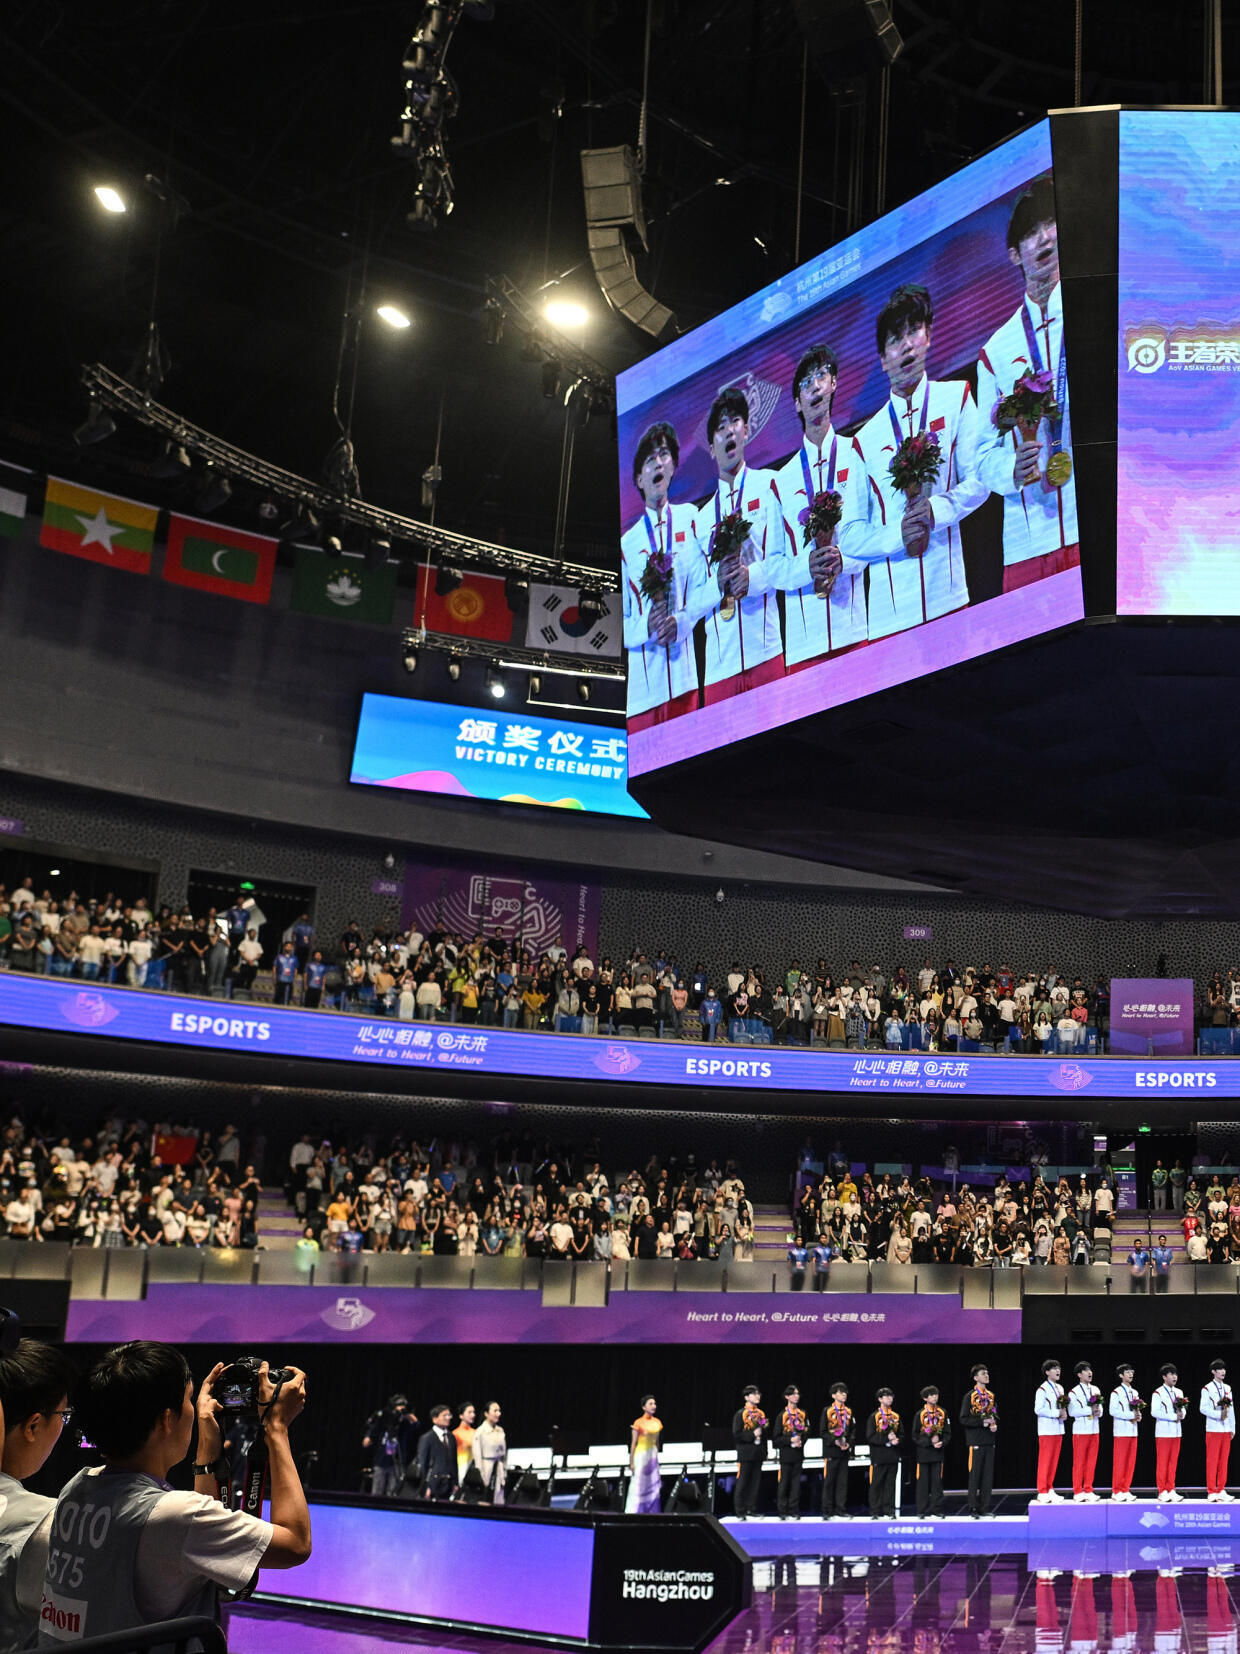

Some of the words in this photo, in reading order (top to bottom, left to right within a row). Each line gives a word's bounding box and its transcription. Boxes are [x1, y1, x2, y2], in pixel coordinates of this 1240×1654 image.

[456, 718, 628, 762] 颁奖仪式
[455, 746, 529, 768] VICTORY
[534, 756, 624, 780] CEREMONY
[0, 819, 15, 831] 07
[910, 929, 926, 937] 309
[171, 1012, 270, 1040] ESPORTS
[353, 1045, 383, 1056] Heart
[387, 1049, 398, 1058] to
[401, 1050, 435, 1063] Heart,
[438, 1053, 483, 1065] @Future
[686, 1058, 772, 1078] ESPORTS
[850, 1077, 877, 1087] Heart
[880, 1078, 889, 1087] to
[893, 1078, 923, 1088] Heart,
[926, 1079, 966, 1088] @Future
[1135, 1072, 1217, 1087] ESPORTS
[687, 1312, 719, 1321] Heart
[722, 1312, 733, 1321] to
[735, 1312, 769, 1323] Heart,
[771, 1312, 818, 1322] @Future
[247, 1472, 262, 1510] Canon
[623, 1569, 646, 1581] 19th
[646, 1569, 676, 1581] Asian
[677, 1570, 715, 1582] Games
[622, 1581, 714, 1602] Hangzhou
